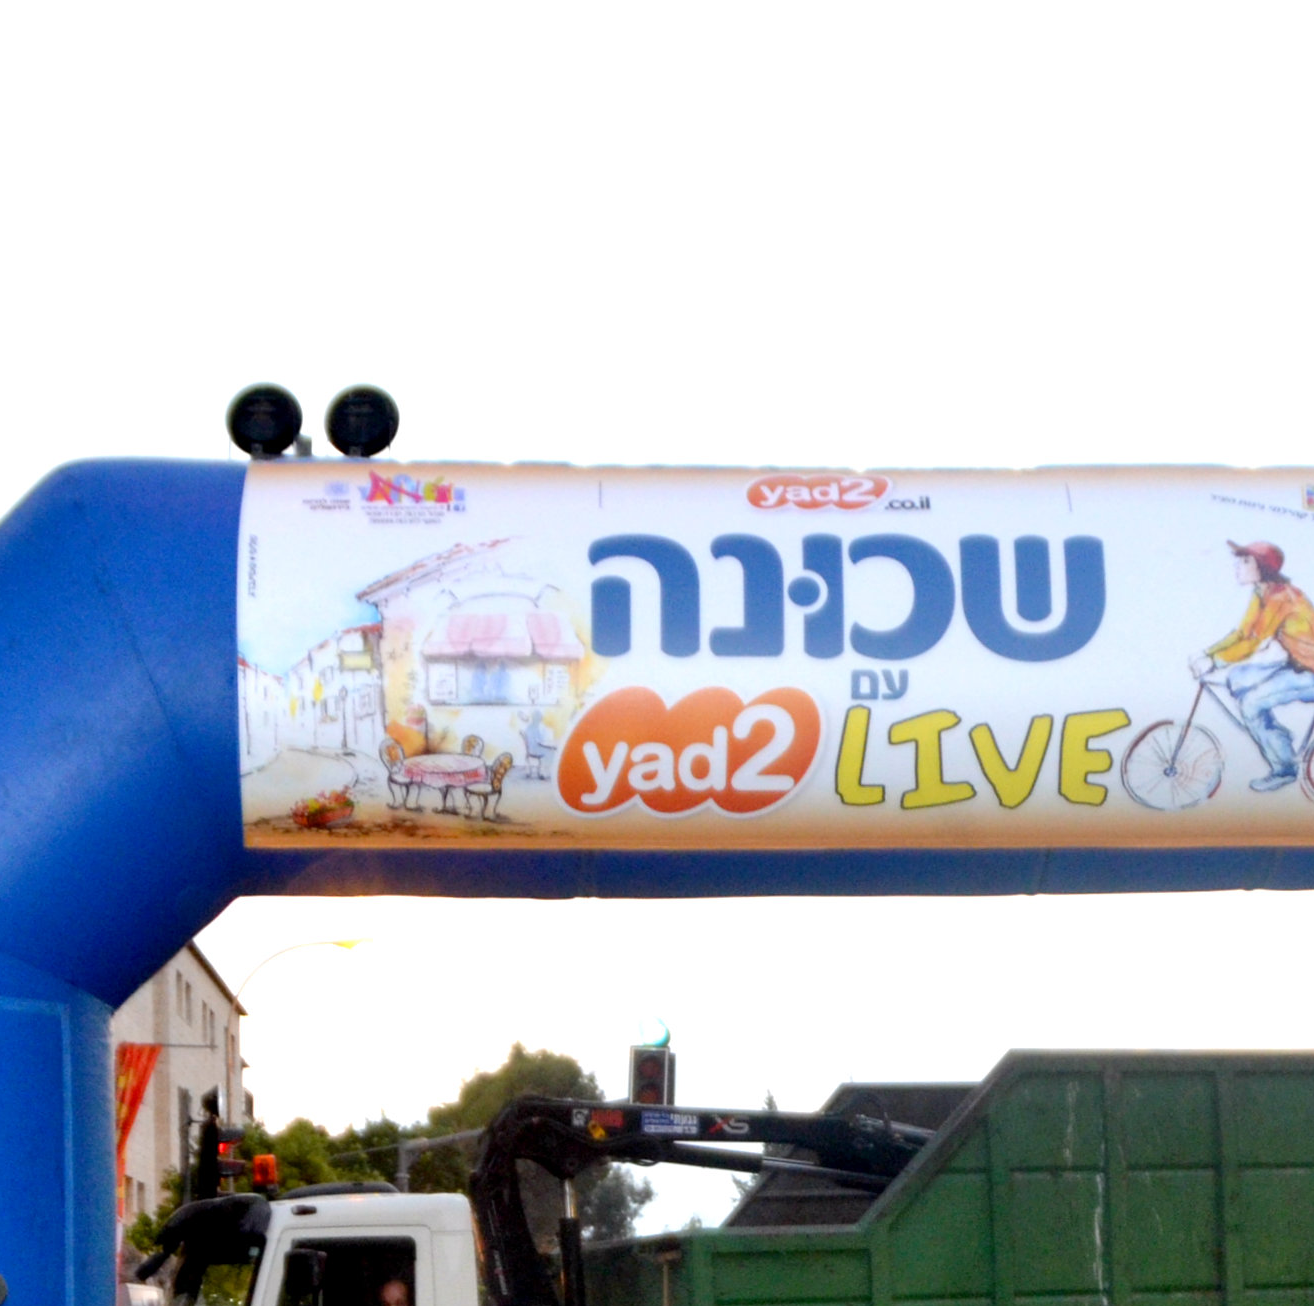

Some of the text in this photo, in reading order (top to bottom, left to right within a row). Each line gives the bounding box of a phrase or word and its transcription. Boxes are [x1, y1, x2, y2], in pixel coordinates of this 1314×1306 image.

[758, 477, 880, 507] yad2
[587, 532, 1107, 662] שכונה
[849, 669, 910, 701] עם
[579, 703, 1132, 810] yad2 LIVE
